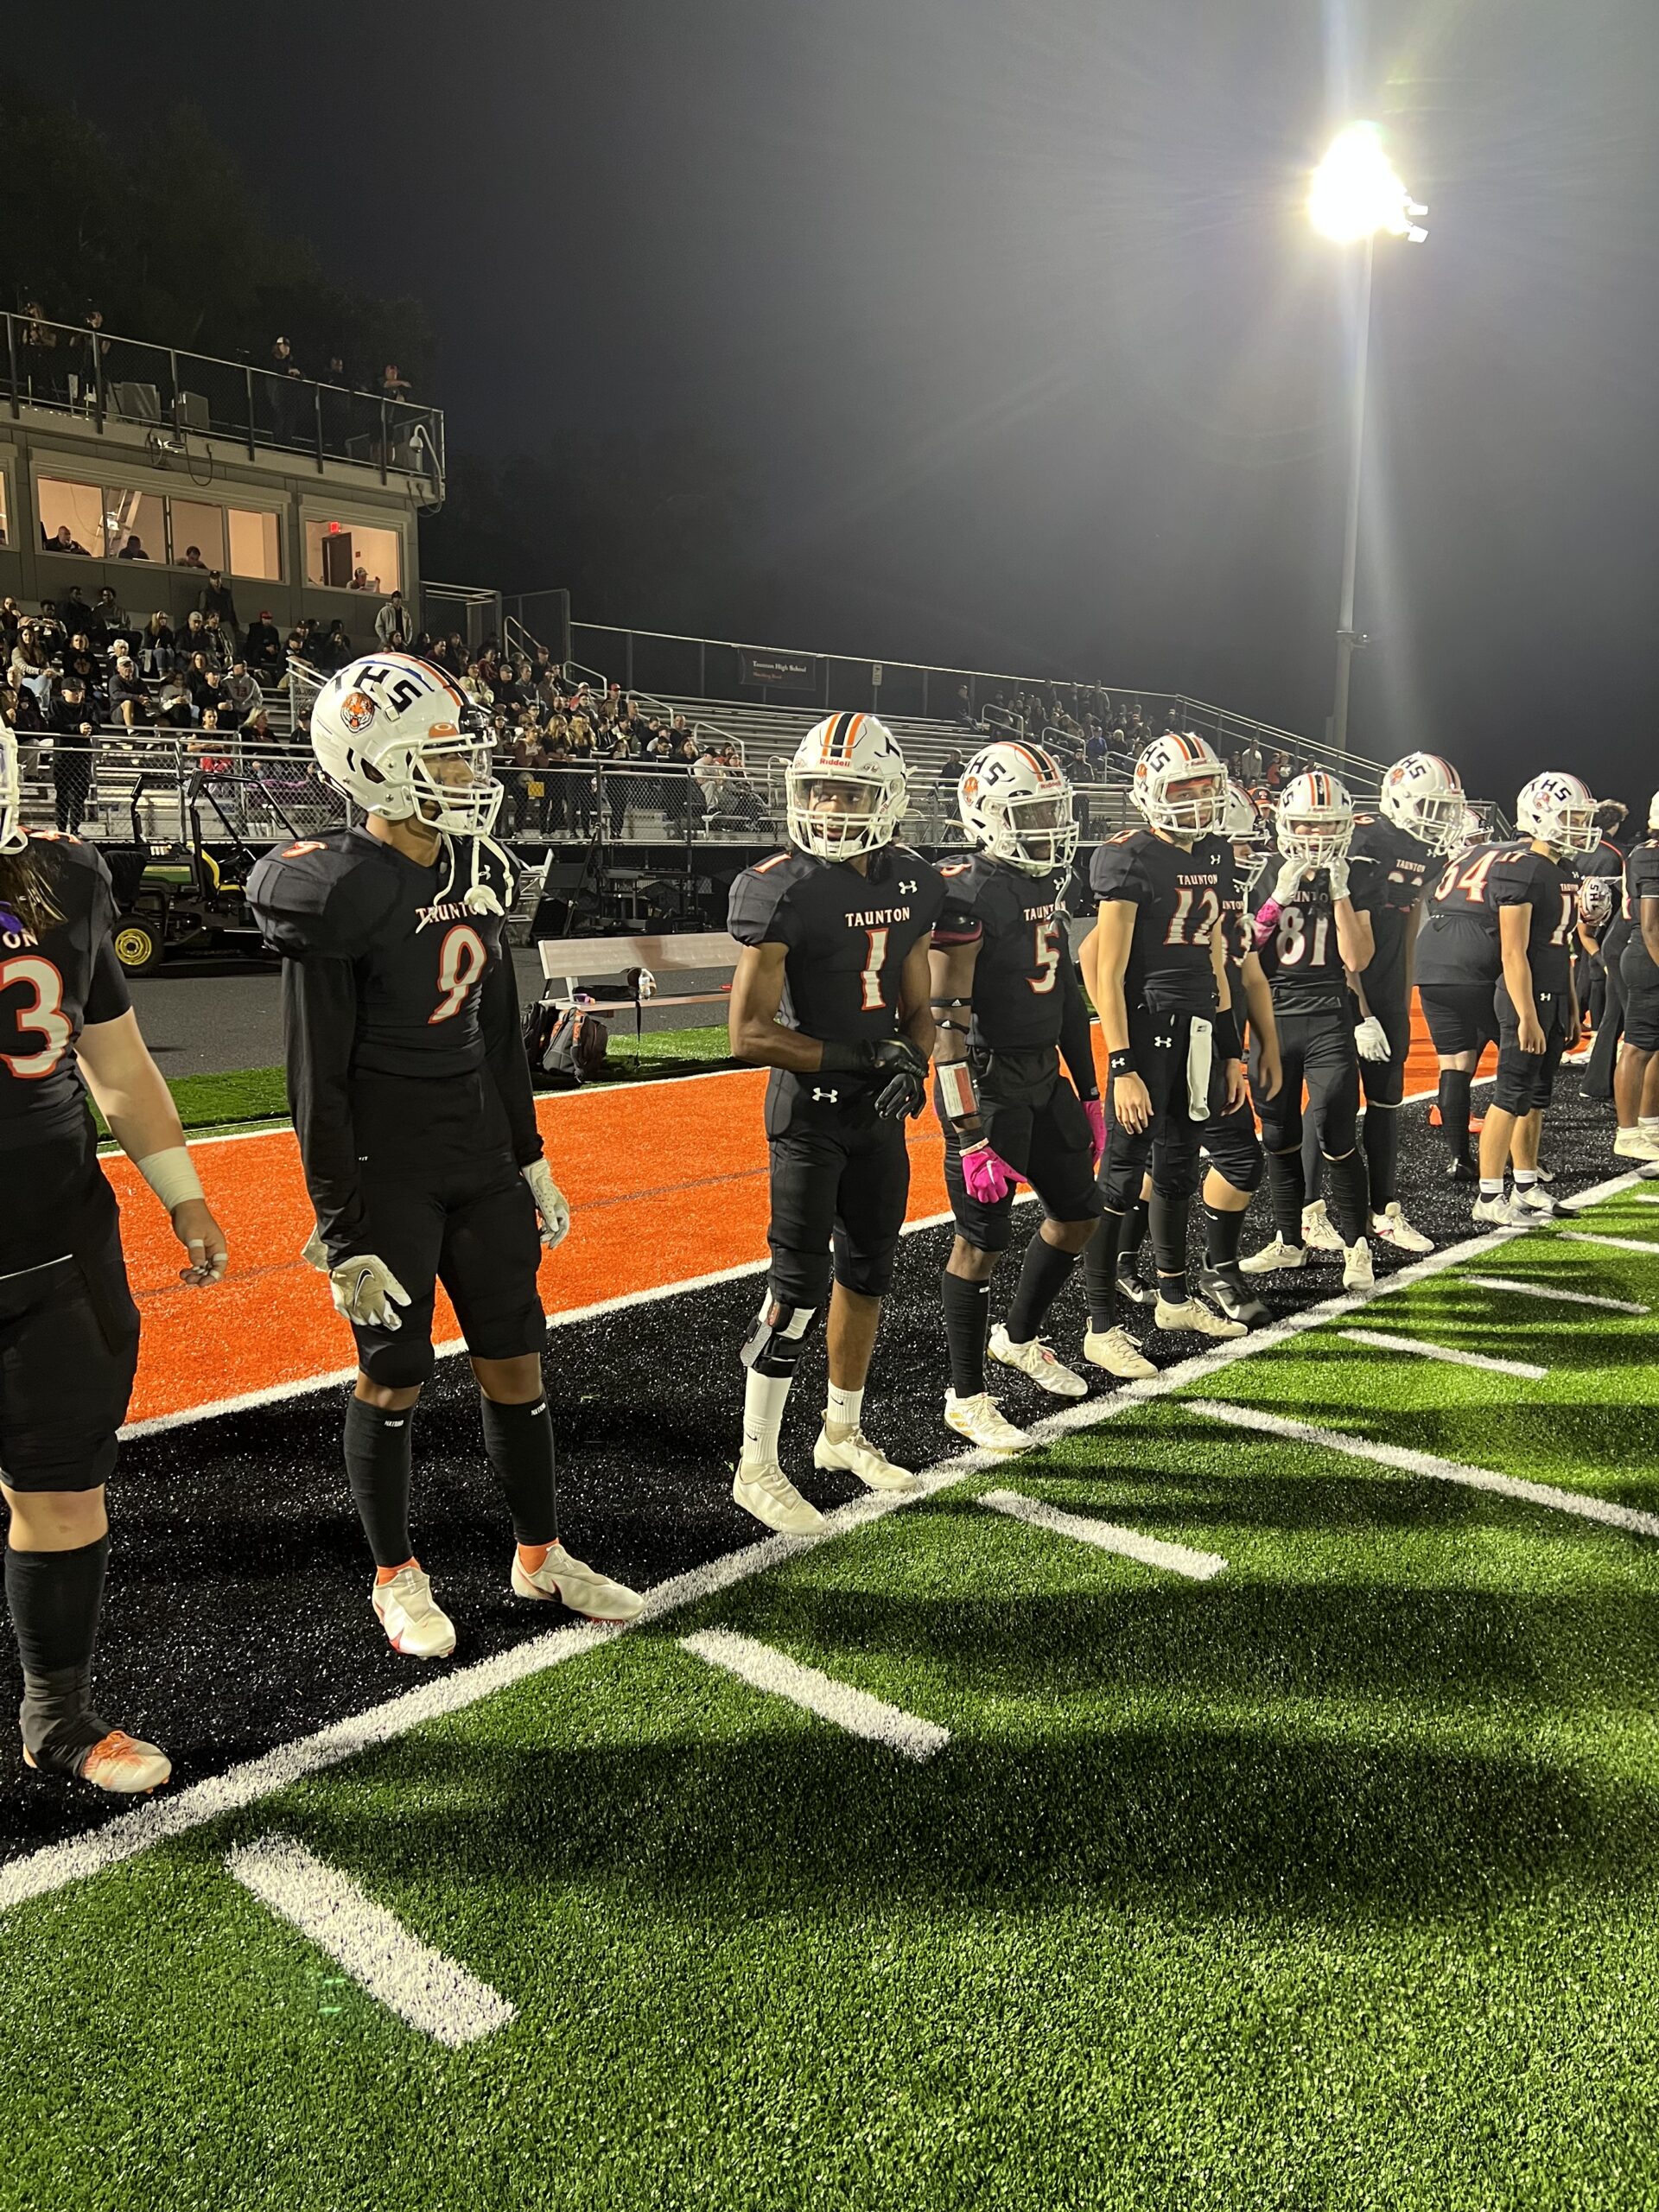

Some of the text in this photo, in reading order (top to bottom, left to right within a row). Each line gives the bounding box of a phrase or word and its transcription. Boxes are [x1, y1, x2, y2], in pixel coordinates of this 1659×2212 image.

[819, 757, 851, 768] Riddell
[1177, 874, 1218, 886] TAUNTON
[845, 906, 910, 927] TAUNTON
[1023, 900, 1066, 922] TAUNTN
[1163, 887, 1219, 945] 12
[1276, 906, 1329, 966] 81
[428, 925, 486, 1024] 9
[861, 927, 889, 1011] 1
[1026, 921, 1060, 995] 5
[0, 955, 73, 1078] 3
